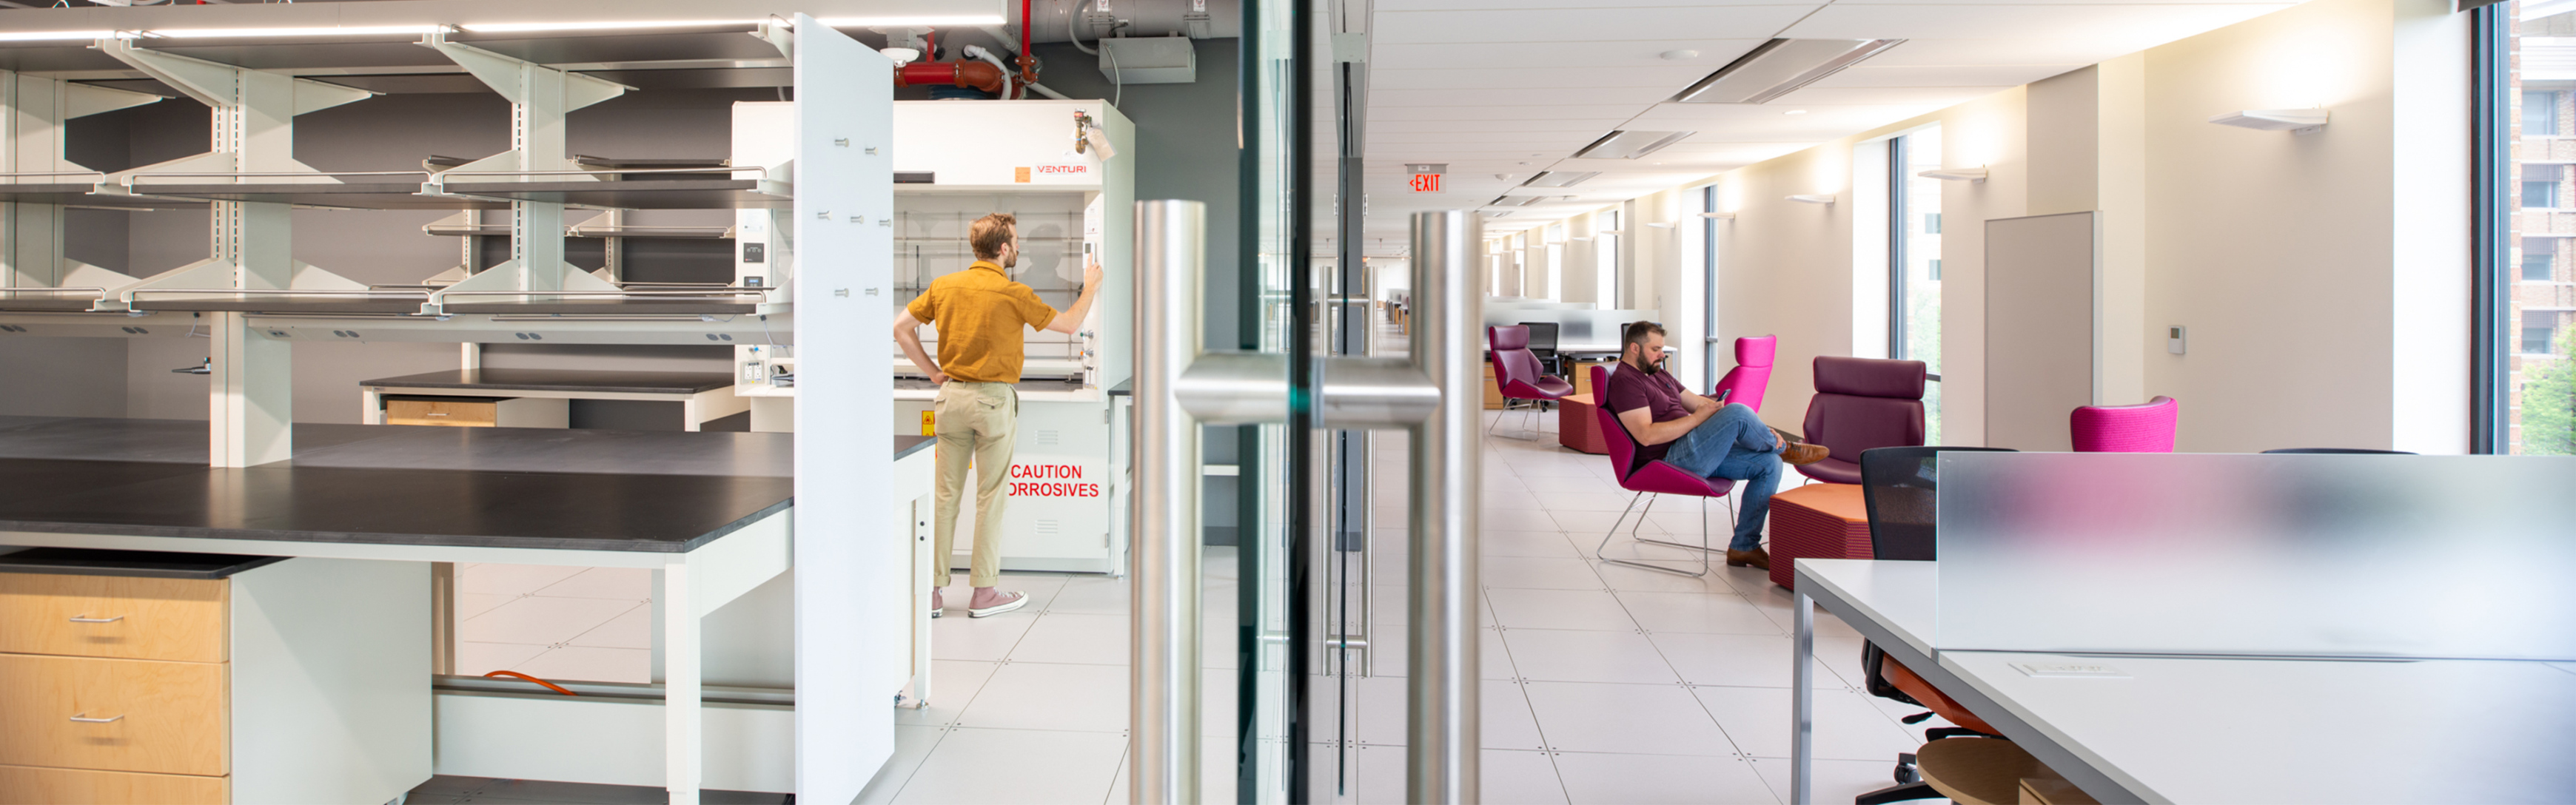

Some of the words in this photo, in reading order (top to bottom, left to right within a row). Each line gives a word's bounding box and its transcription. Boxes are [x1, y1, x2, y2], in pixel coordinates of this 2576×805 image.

[1415, 174, 1440, 192] EXIT
[1011, 465, 1081, 479] CAUTION
[1009, 482, 1099, 497] ORROSIVES
